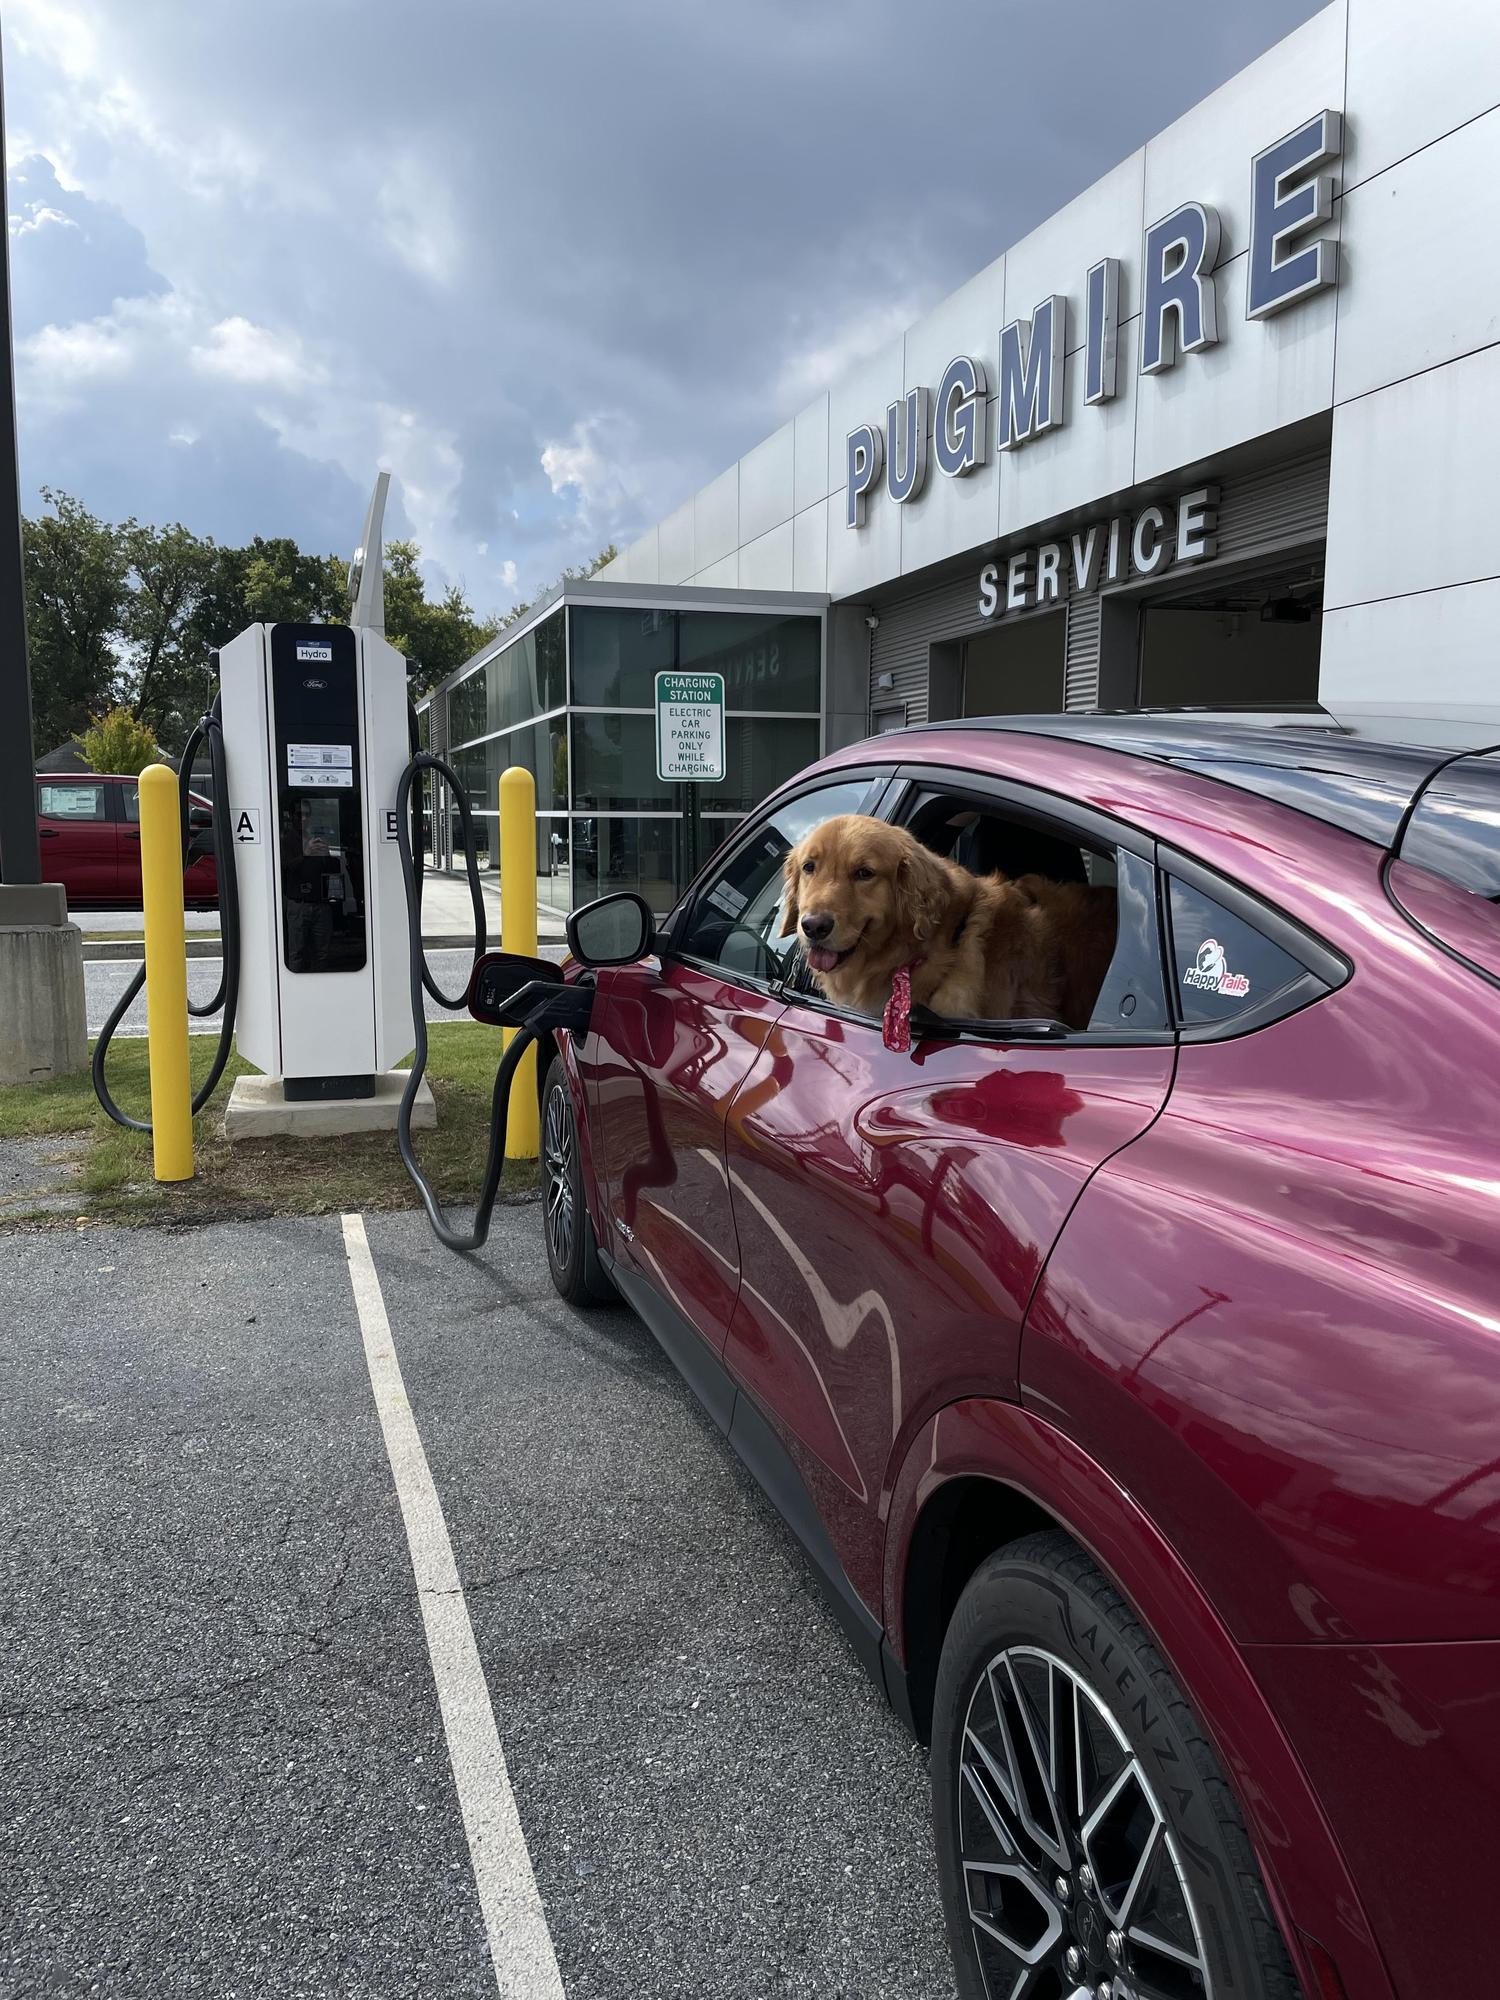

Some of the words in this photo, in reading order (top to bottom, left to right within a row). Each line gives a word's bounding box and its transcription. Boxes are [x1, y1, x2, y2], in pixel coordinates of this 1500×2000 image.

[847, 109, 1342, 528] PUGMIRE
[978, 486, 1220, 618] SERVICE
[301, 650, 327, 659] Hydro
[664, 678, 716, 689] CHARGING
[670, 690, 711, 701] STATION
[669, 707, 712, 718] ELECTRIC
[681, 719, 700, 728] CAR
[671, 730, 711, 740] PARKING
[678, 741, 703, 751] ONLY
[678, 753, 705, 762] WHILE
[668, 763, 715, 773] CHARGING
[237, 811, 254, 833] A
[1081, 1624, 1195, 1816] ALENZA
